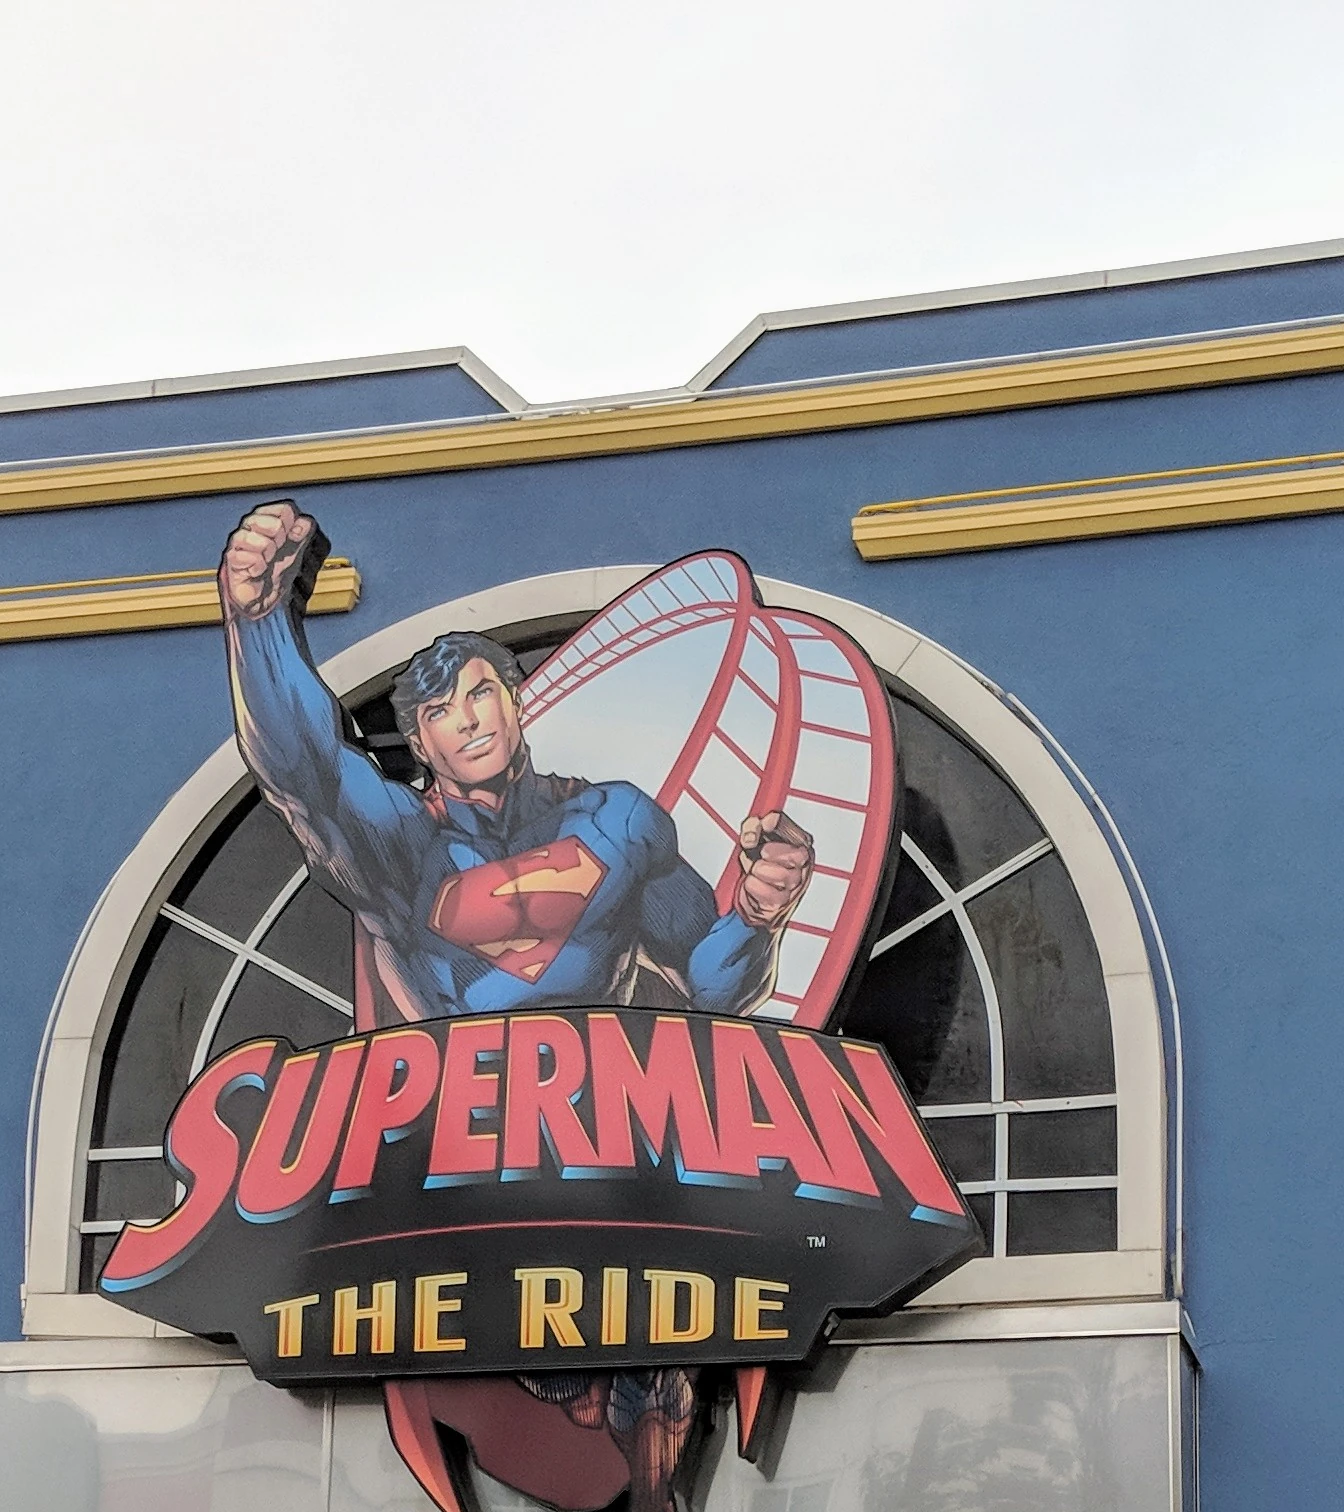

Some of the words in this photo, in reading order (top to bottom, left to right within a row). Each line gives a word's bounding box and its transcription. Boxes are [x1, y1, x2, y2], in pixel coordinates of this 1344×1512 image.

[100, 1014, 969, 1292] SUPERMAN
[806, 1235, 827, 1248] TM
[264, 1273, 467, 1358] THE
[515, 1266, 791, 1350] RIDE
